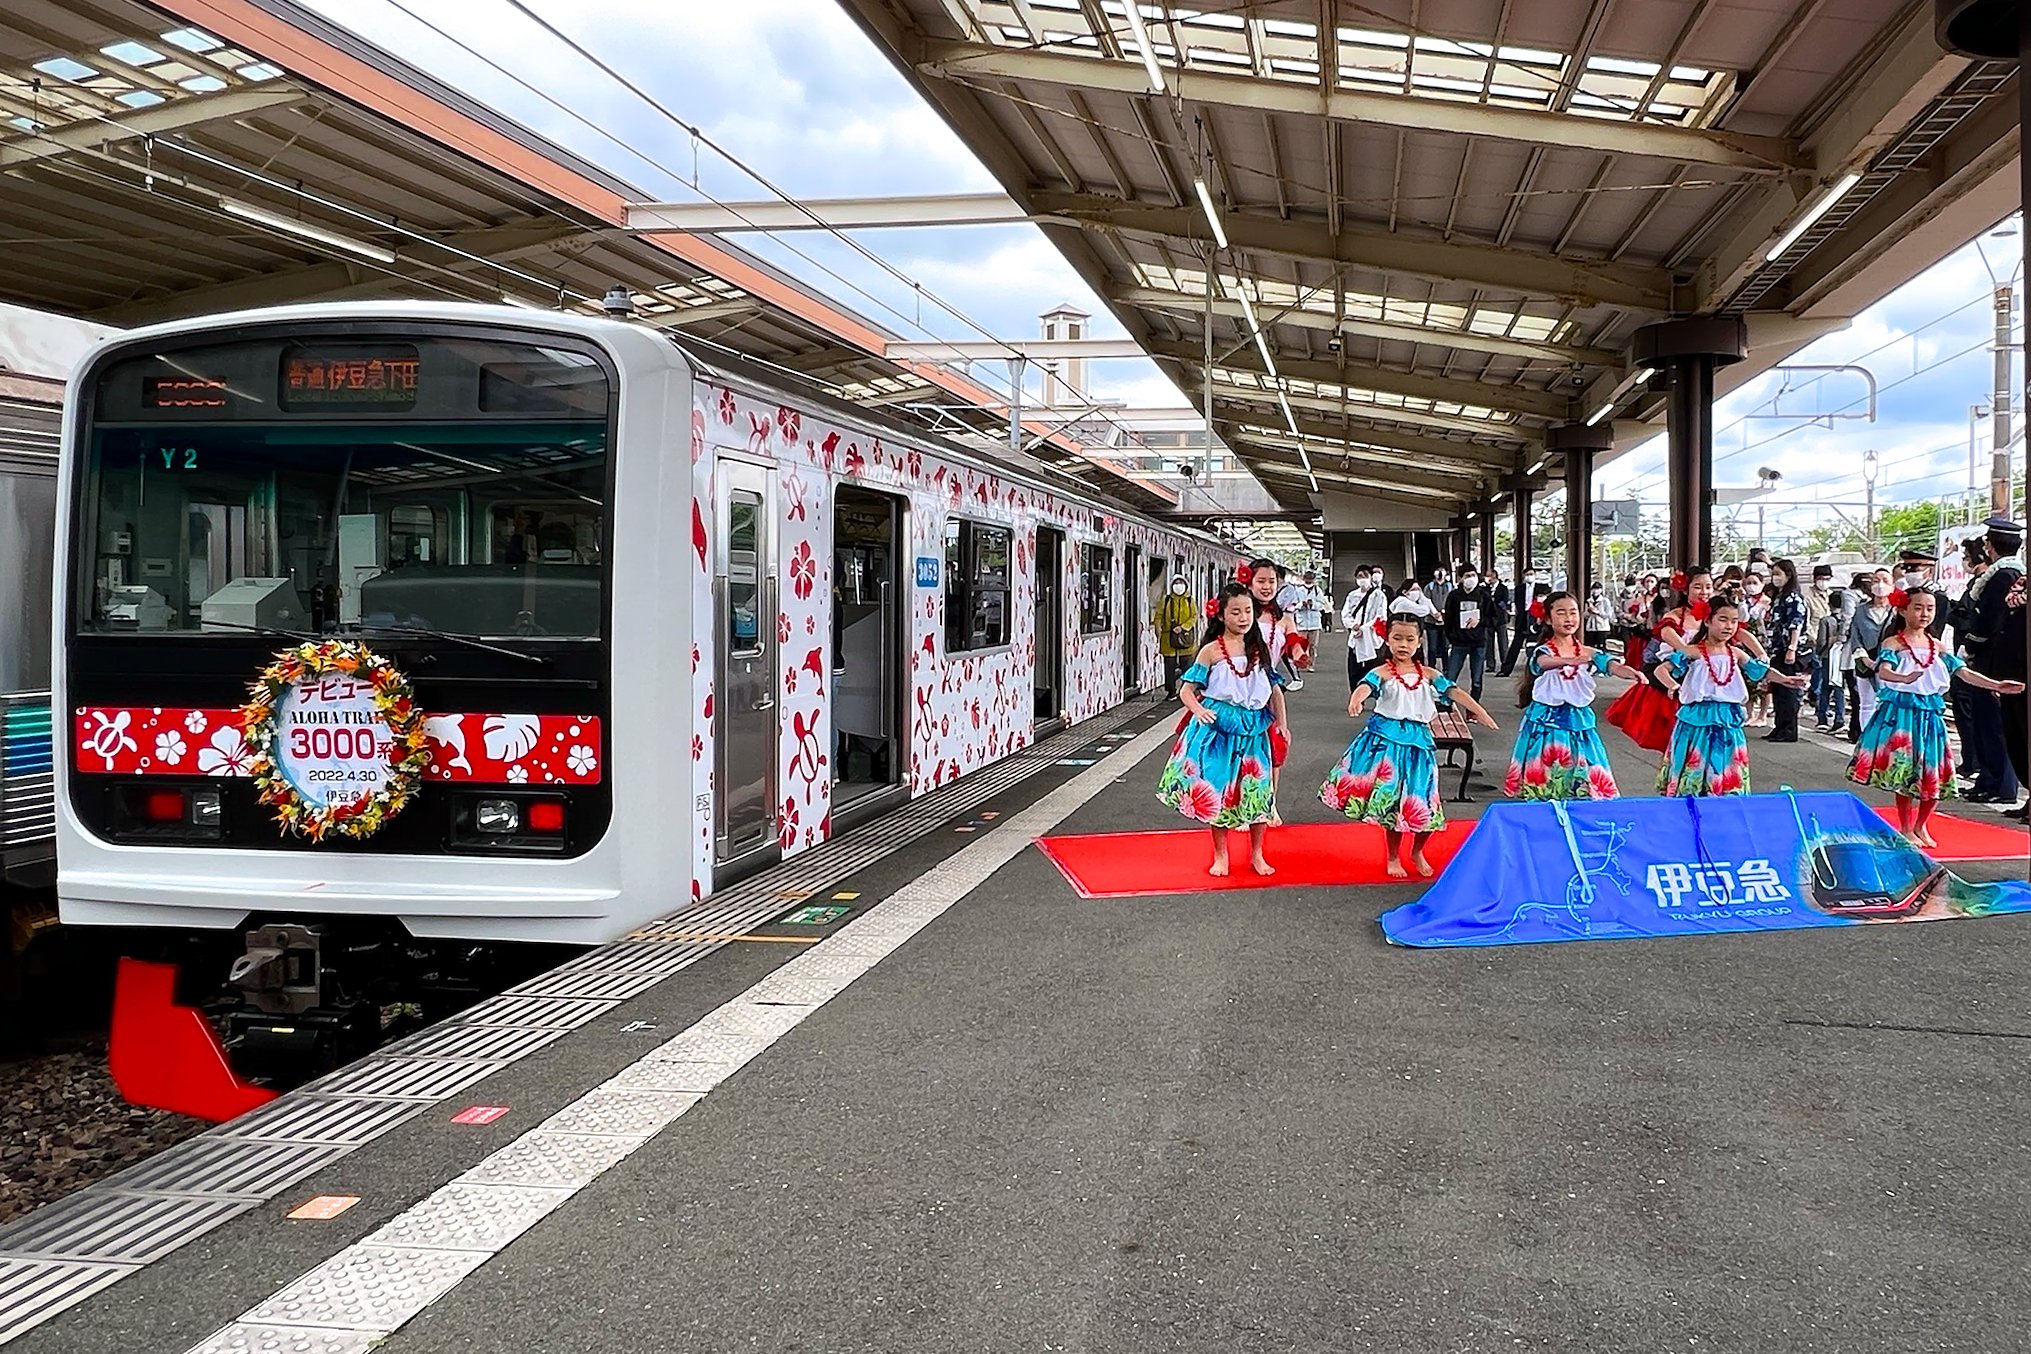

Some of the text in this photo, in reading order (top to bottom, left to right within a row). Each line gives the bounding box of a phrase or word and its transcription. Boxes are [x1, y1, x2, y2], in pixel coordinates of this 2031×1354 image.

[300, 678, 375, 704] デビュー
[289, 711, 340, 725] ALOHA
[309, 770, 378, 783] 2022.4.30
[1646, 859, 1793, 908] 伊豆急
[1734, 906, 1793, 919] GROUP
